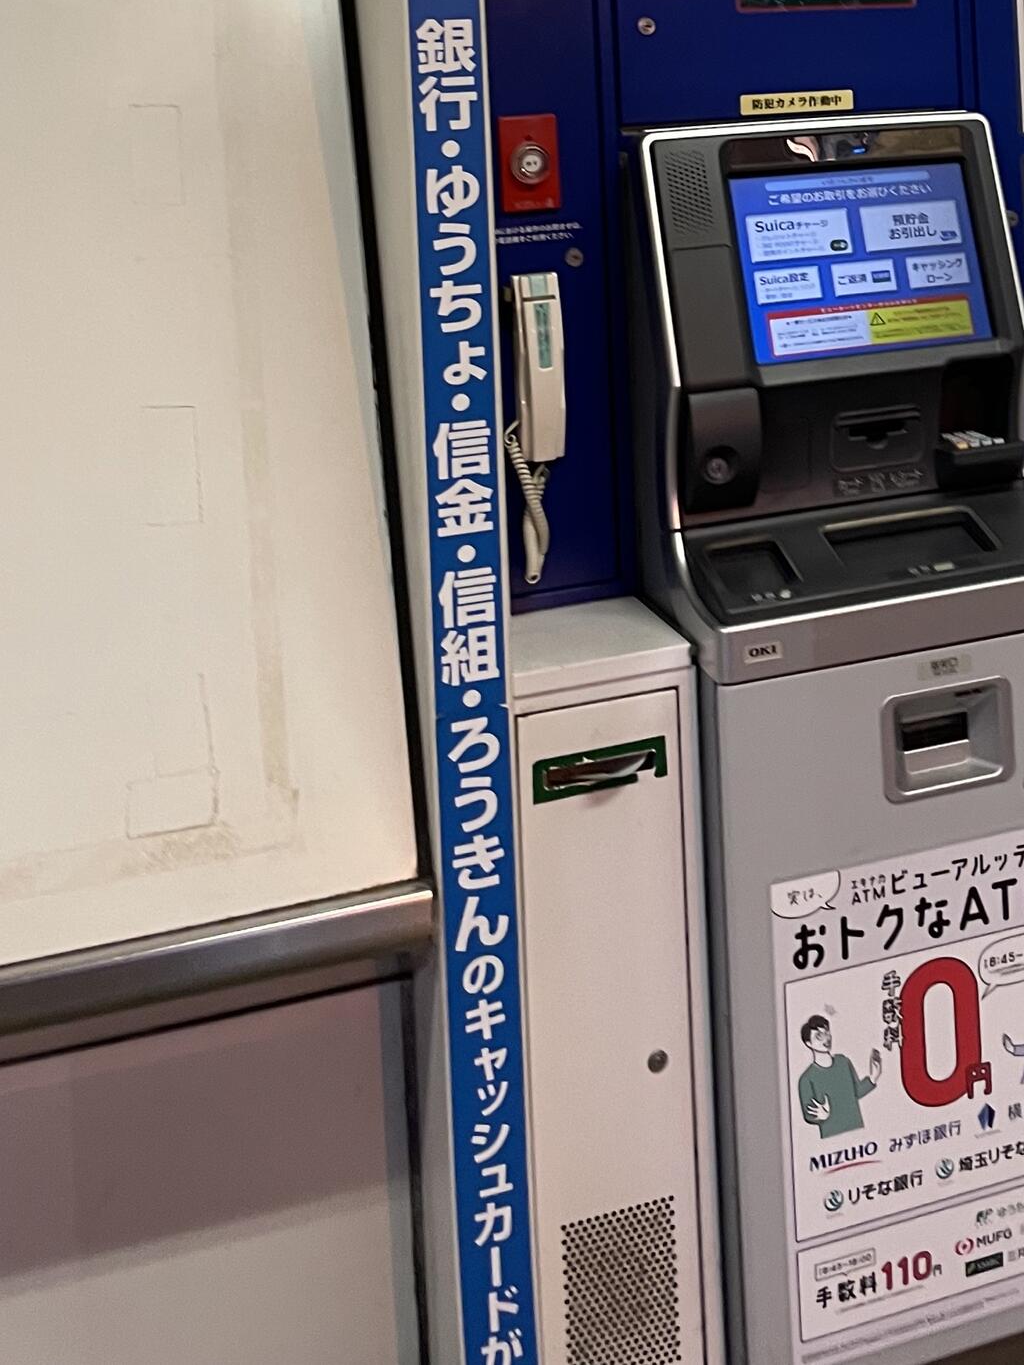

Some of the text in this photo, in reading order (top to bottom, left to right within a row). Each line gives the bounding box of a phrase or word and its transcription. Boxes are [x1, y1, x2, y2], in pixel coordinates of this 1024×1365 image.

[748, 645, 777, 658] OKI
[851, 886, 886, 906] ATM
[809, 1141, 879, 1173] MIZUHO
[847, 1170, 923, 1205] りそな銀行
